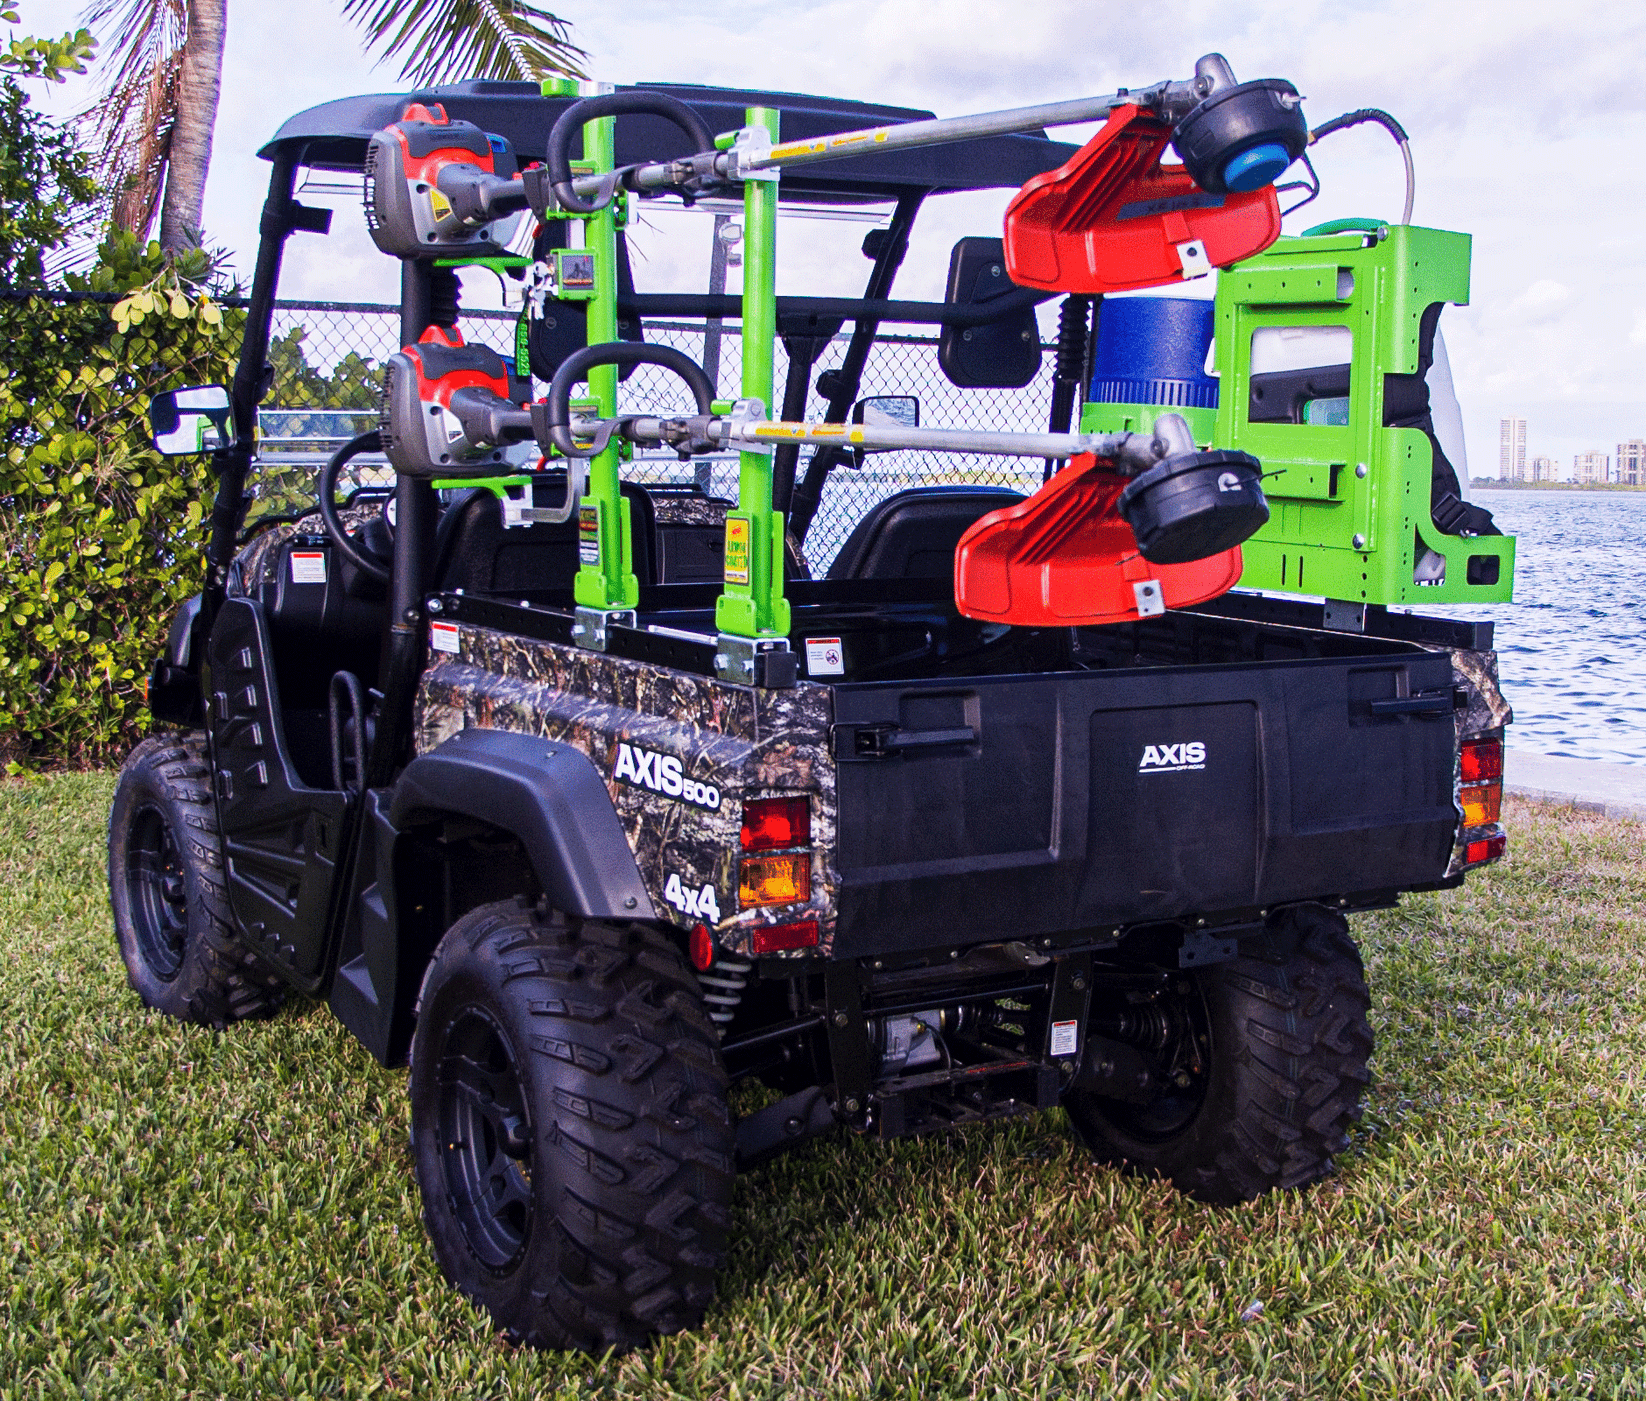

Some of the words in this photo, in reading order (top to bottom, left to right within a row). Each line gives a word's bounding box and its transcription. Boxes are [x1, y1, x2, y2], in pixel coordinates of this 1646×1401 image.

[614, 743, 683, 796] AXIS
[682, 778, 720, 808] 500
[1140, 742, 1206, 767] AXIS
[664, 873, 721, 924] 4x4
